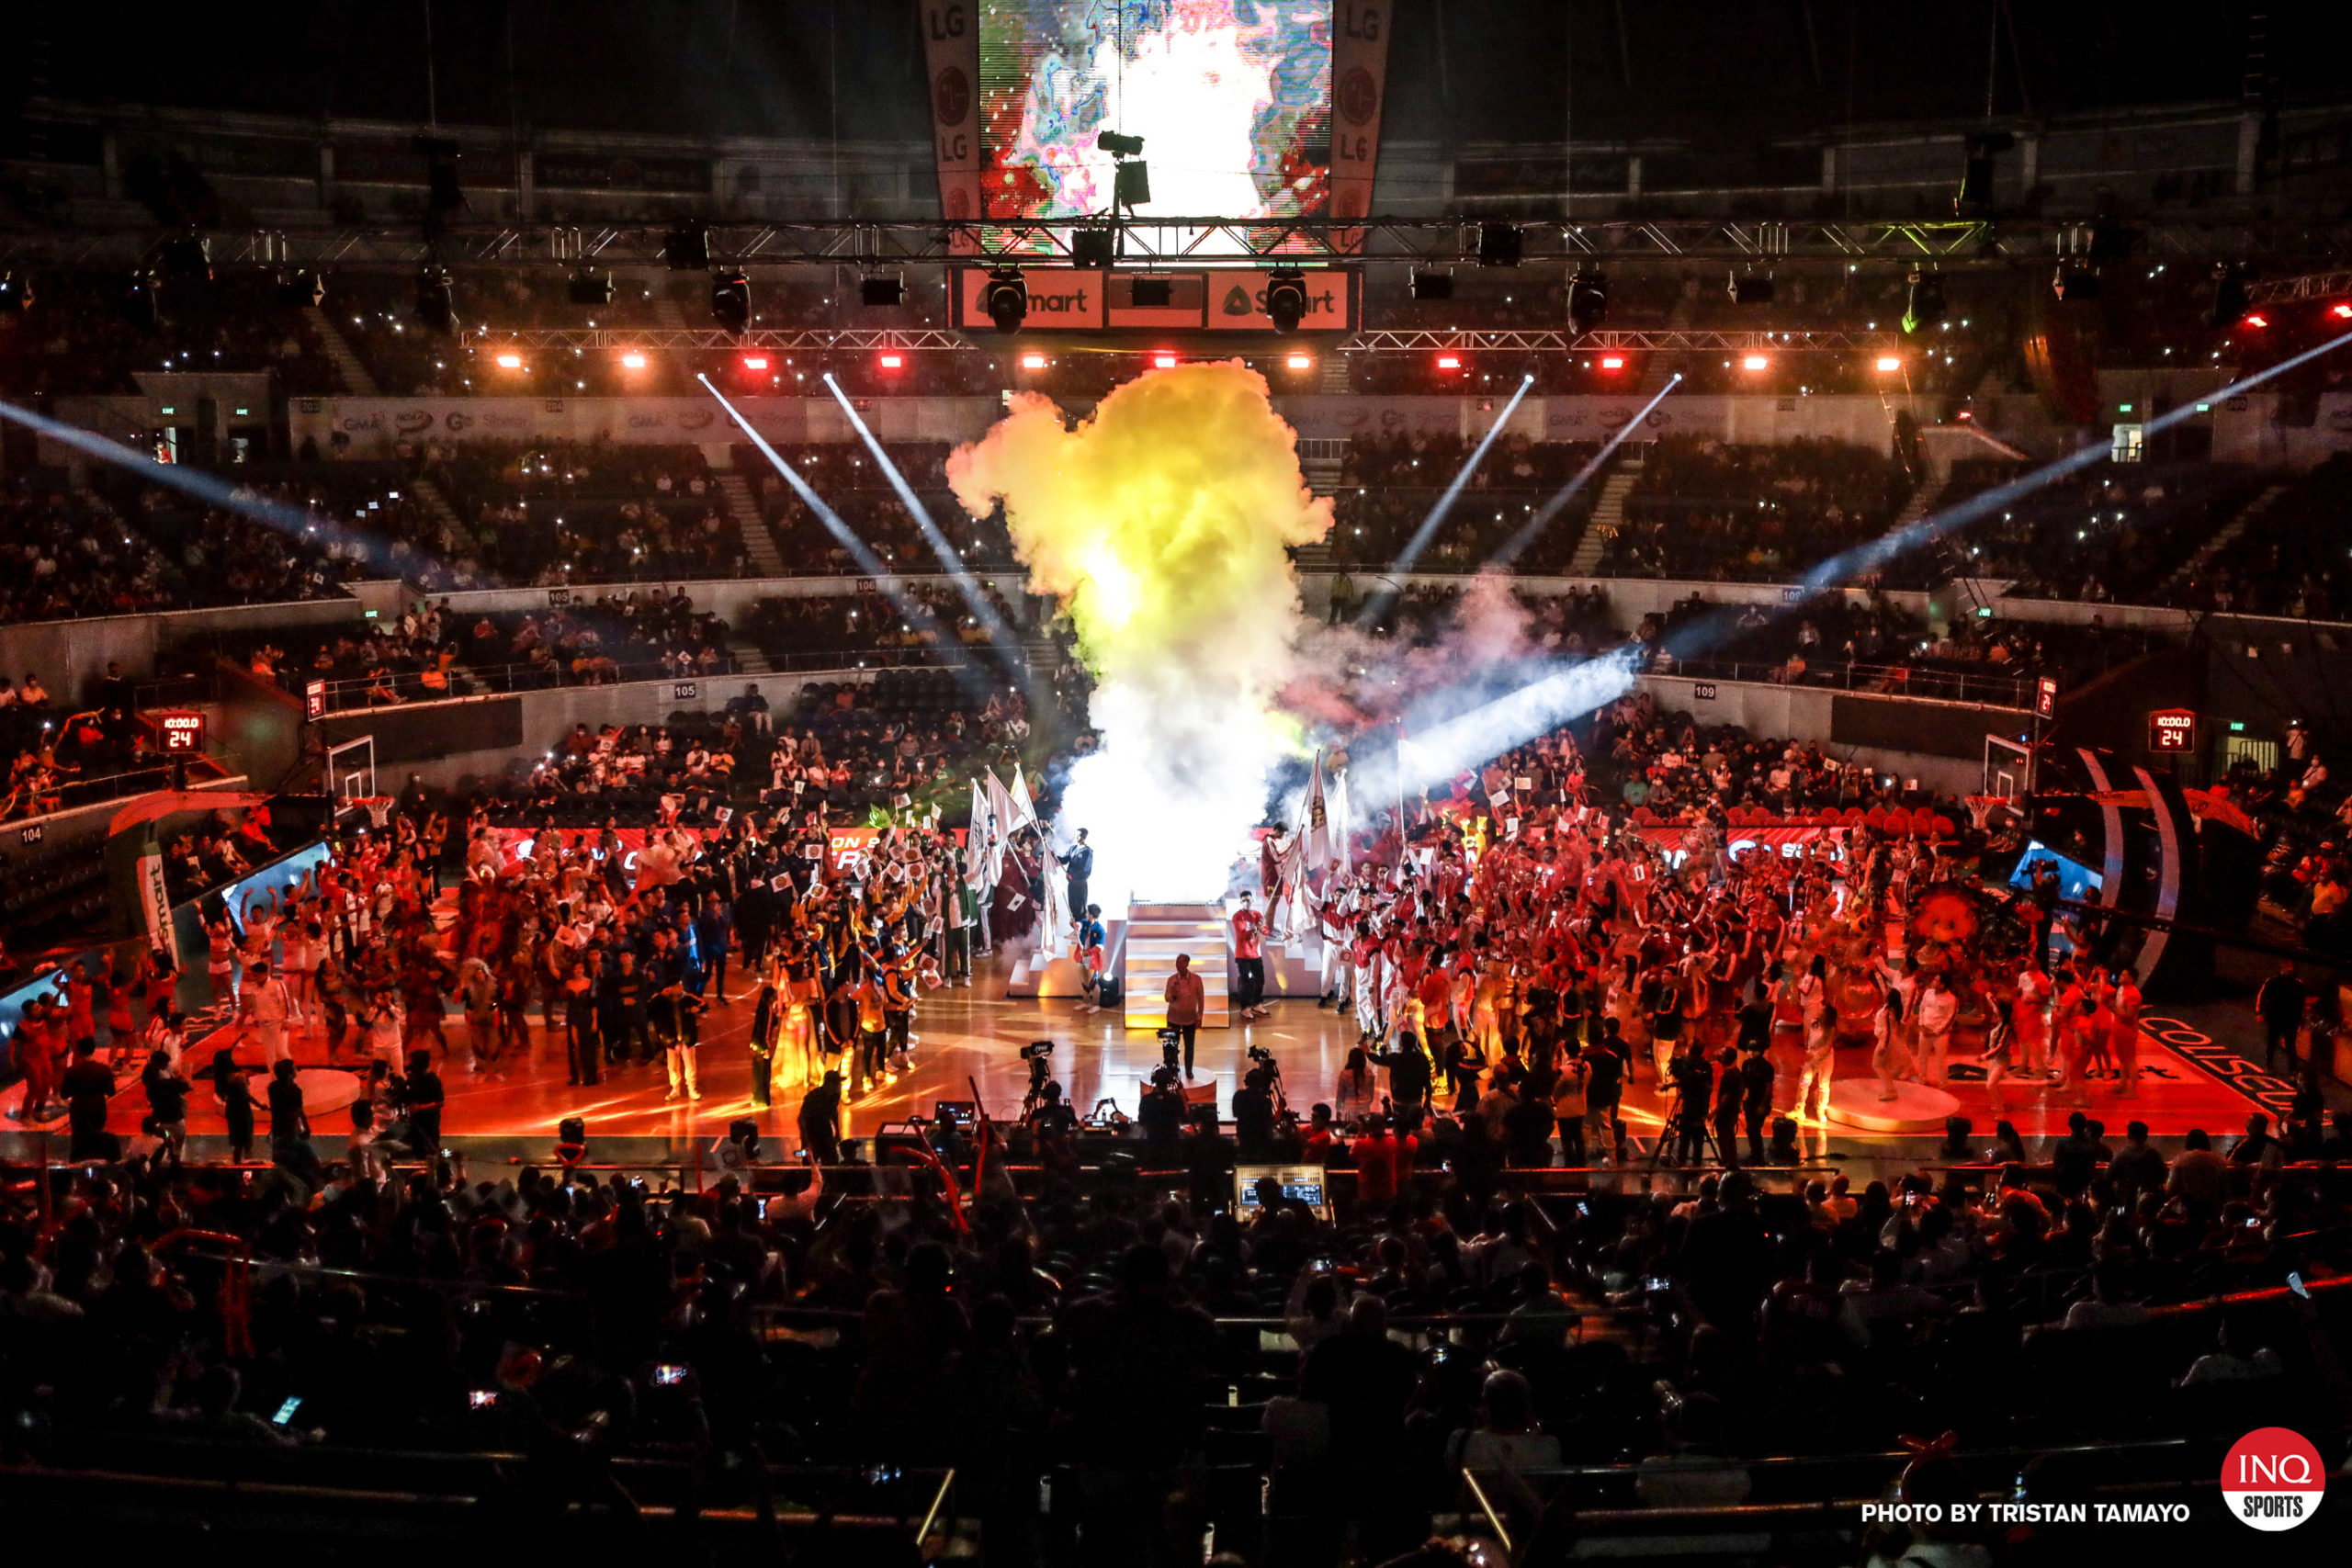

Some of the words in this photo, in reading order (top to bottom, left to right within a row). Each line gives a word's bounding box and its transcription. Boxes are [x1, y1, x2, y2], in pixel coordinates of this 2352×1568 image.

[932, 6, 965, 40] LG
[1346, 0, 1378, 41] LG
[942, 134, 967, 162] LG
[1340, 134, 1367, 162] LG
[1027, 288, 1087, 312] mart
[1255, 289, 1334, 313] Srt
[675, 685, 695, 696] 105
[1696, 685, 1714, 697] 109
[169, 730, 191, 748] 24
[2162, 729, 2183, 746] 24
[22, 827, 41, 843] 104
